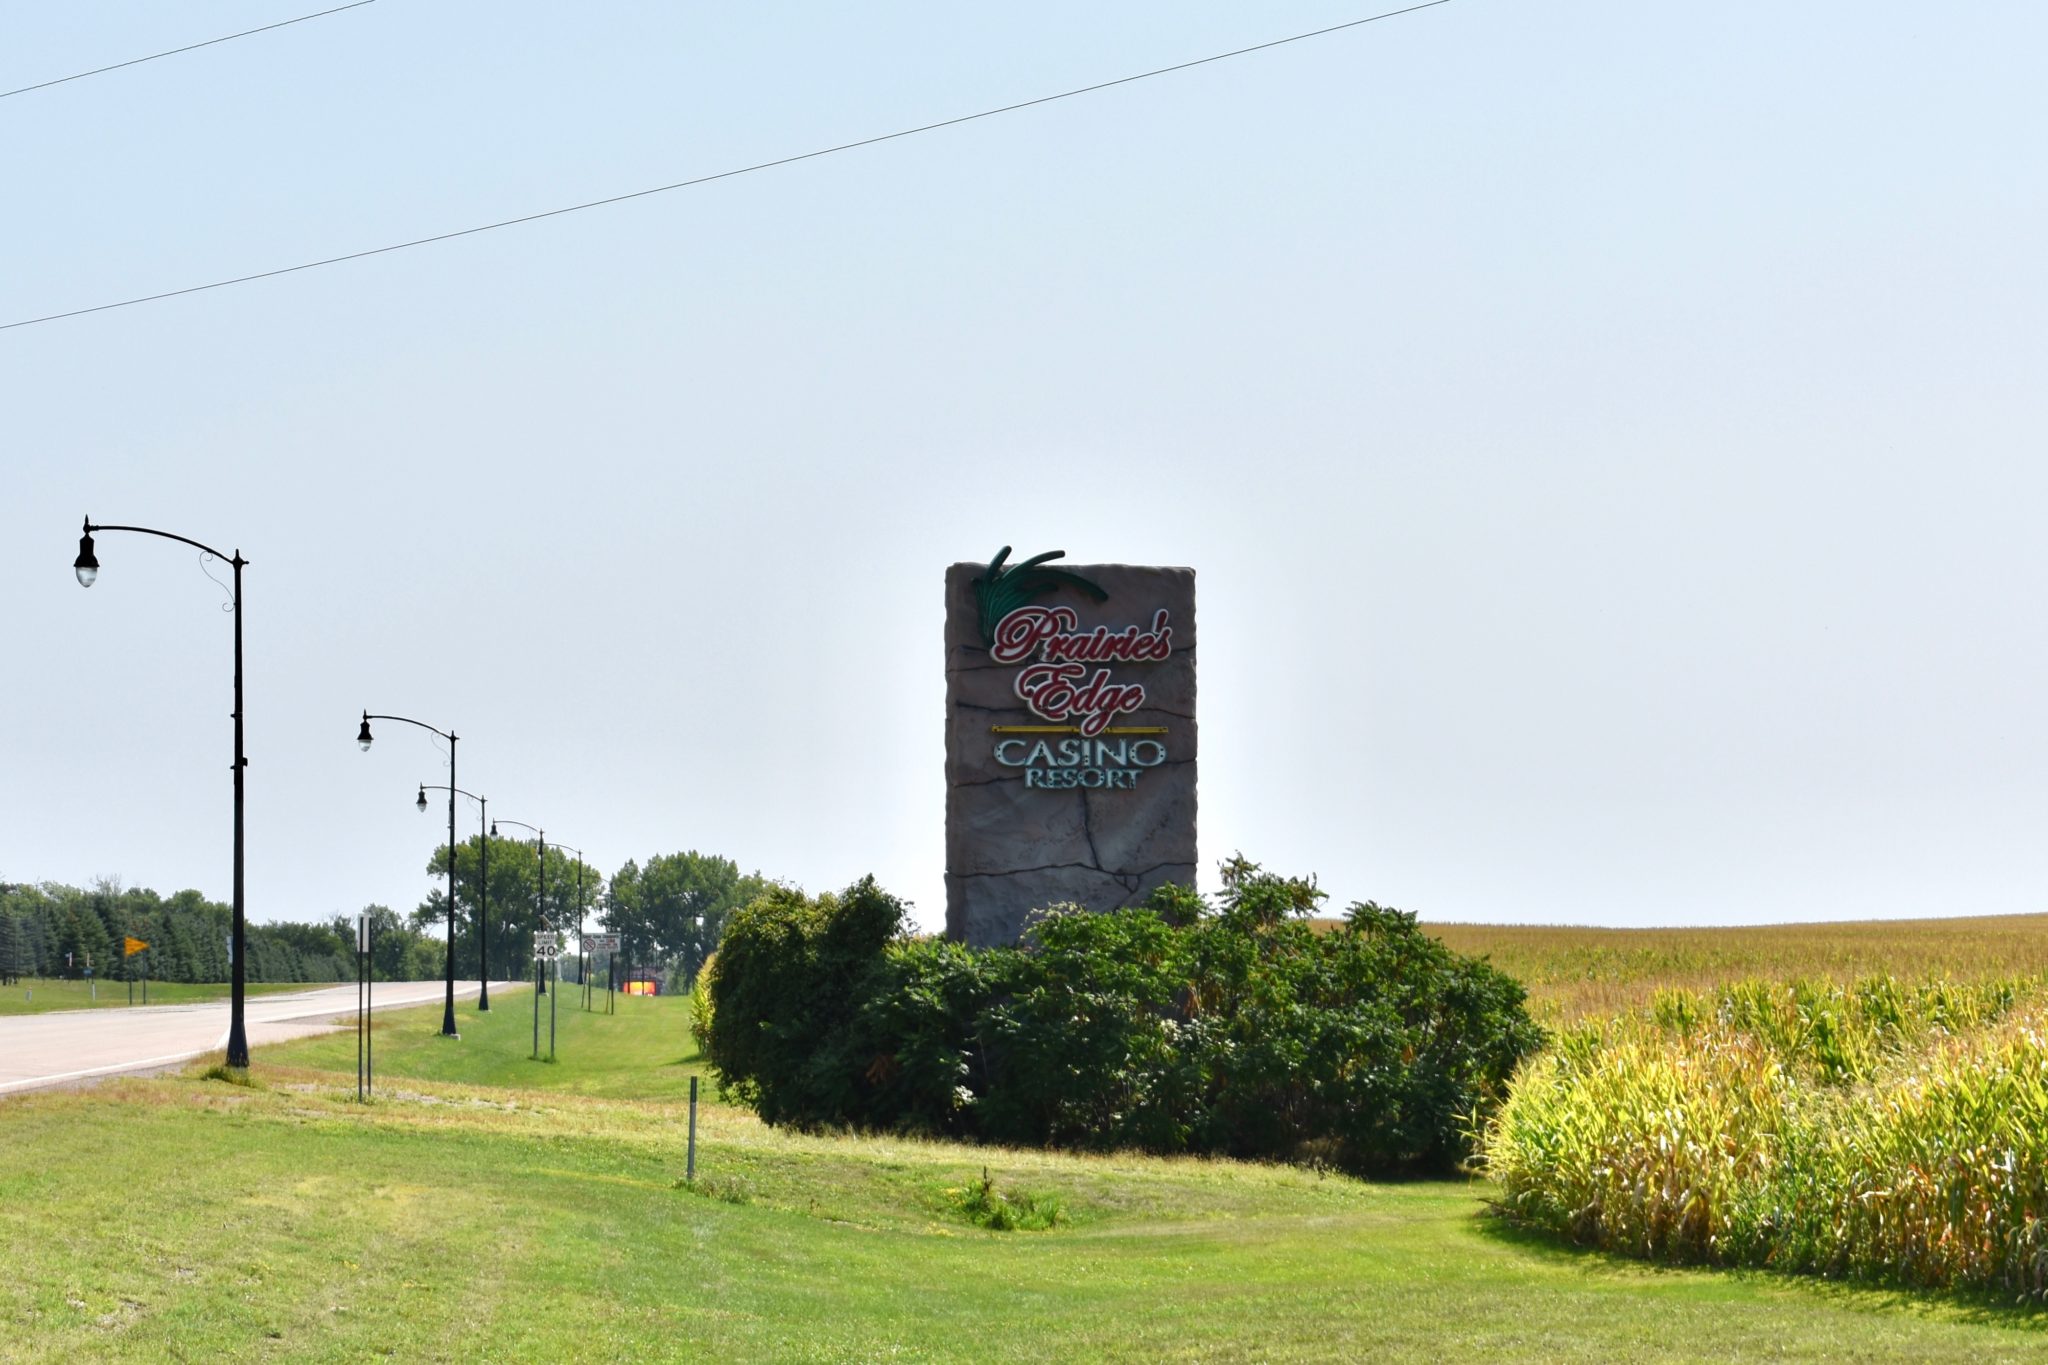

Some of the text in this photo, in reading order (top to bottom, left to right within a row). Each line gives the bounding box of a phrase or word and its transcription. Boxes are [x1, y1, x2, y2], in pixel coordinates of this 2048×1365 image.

[991, 606, 1173, 663] Prairie's
[1014, 663, 1145, 737] Edge
[993, 739, 1167, 767] CASINO
[1025, 768, 1143, 788] RESORT
[536, 945, 556, 956] 40
